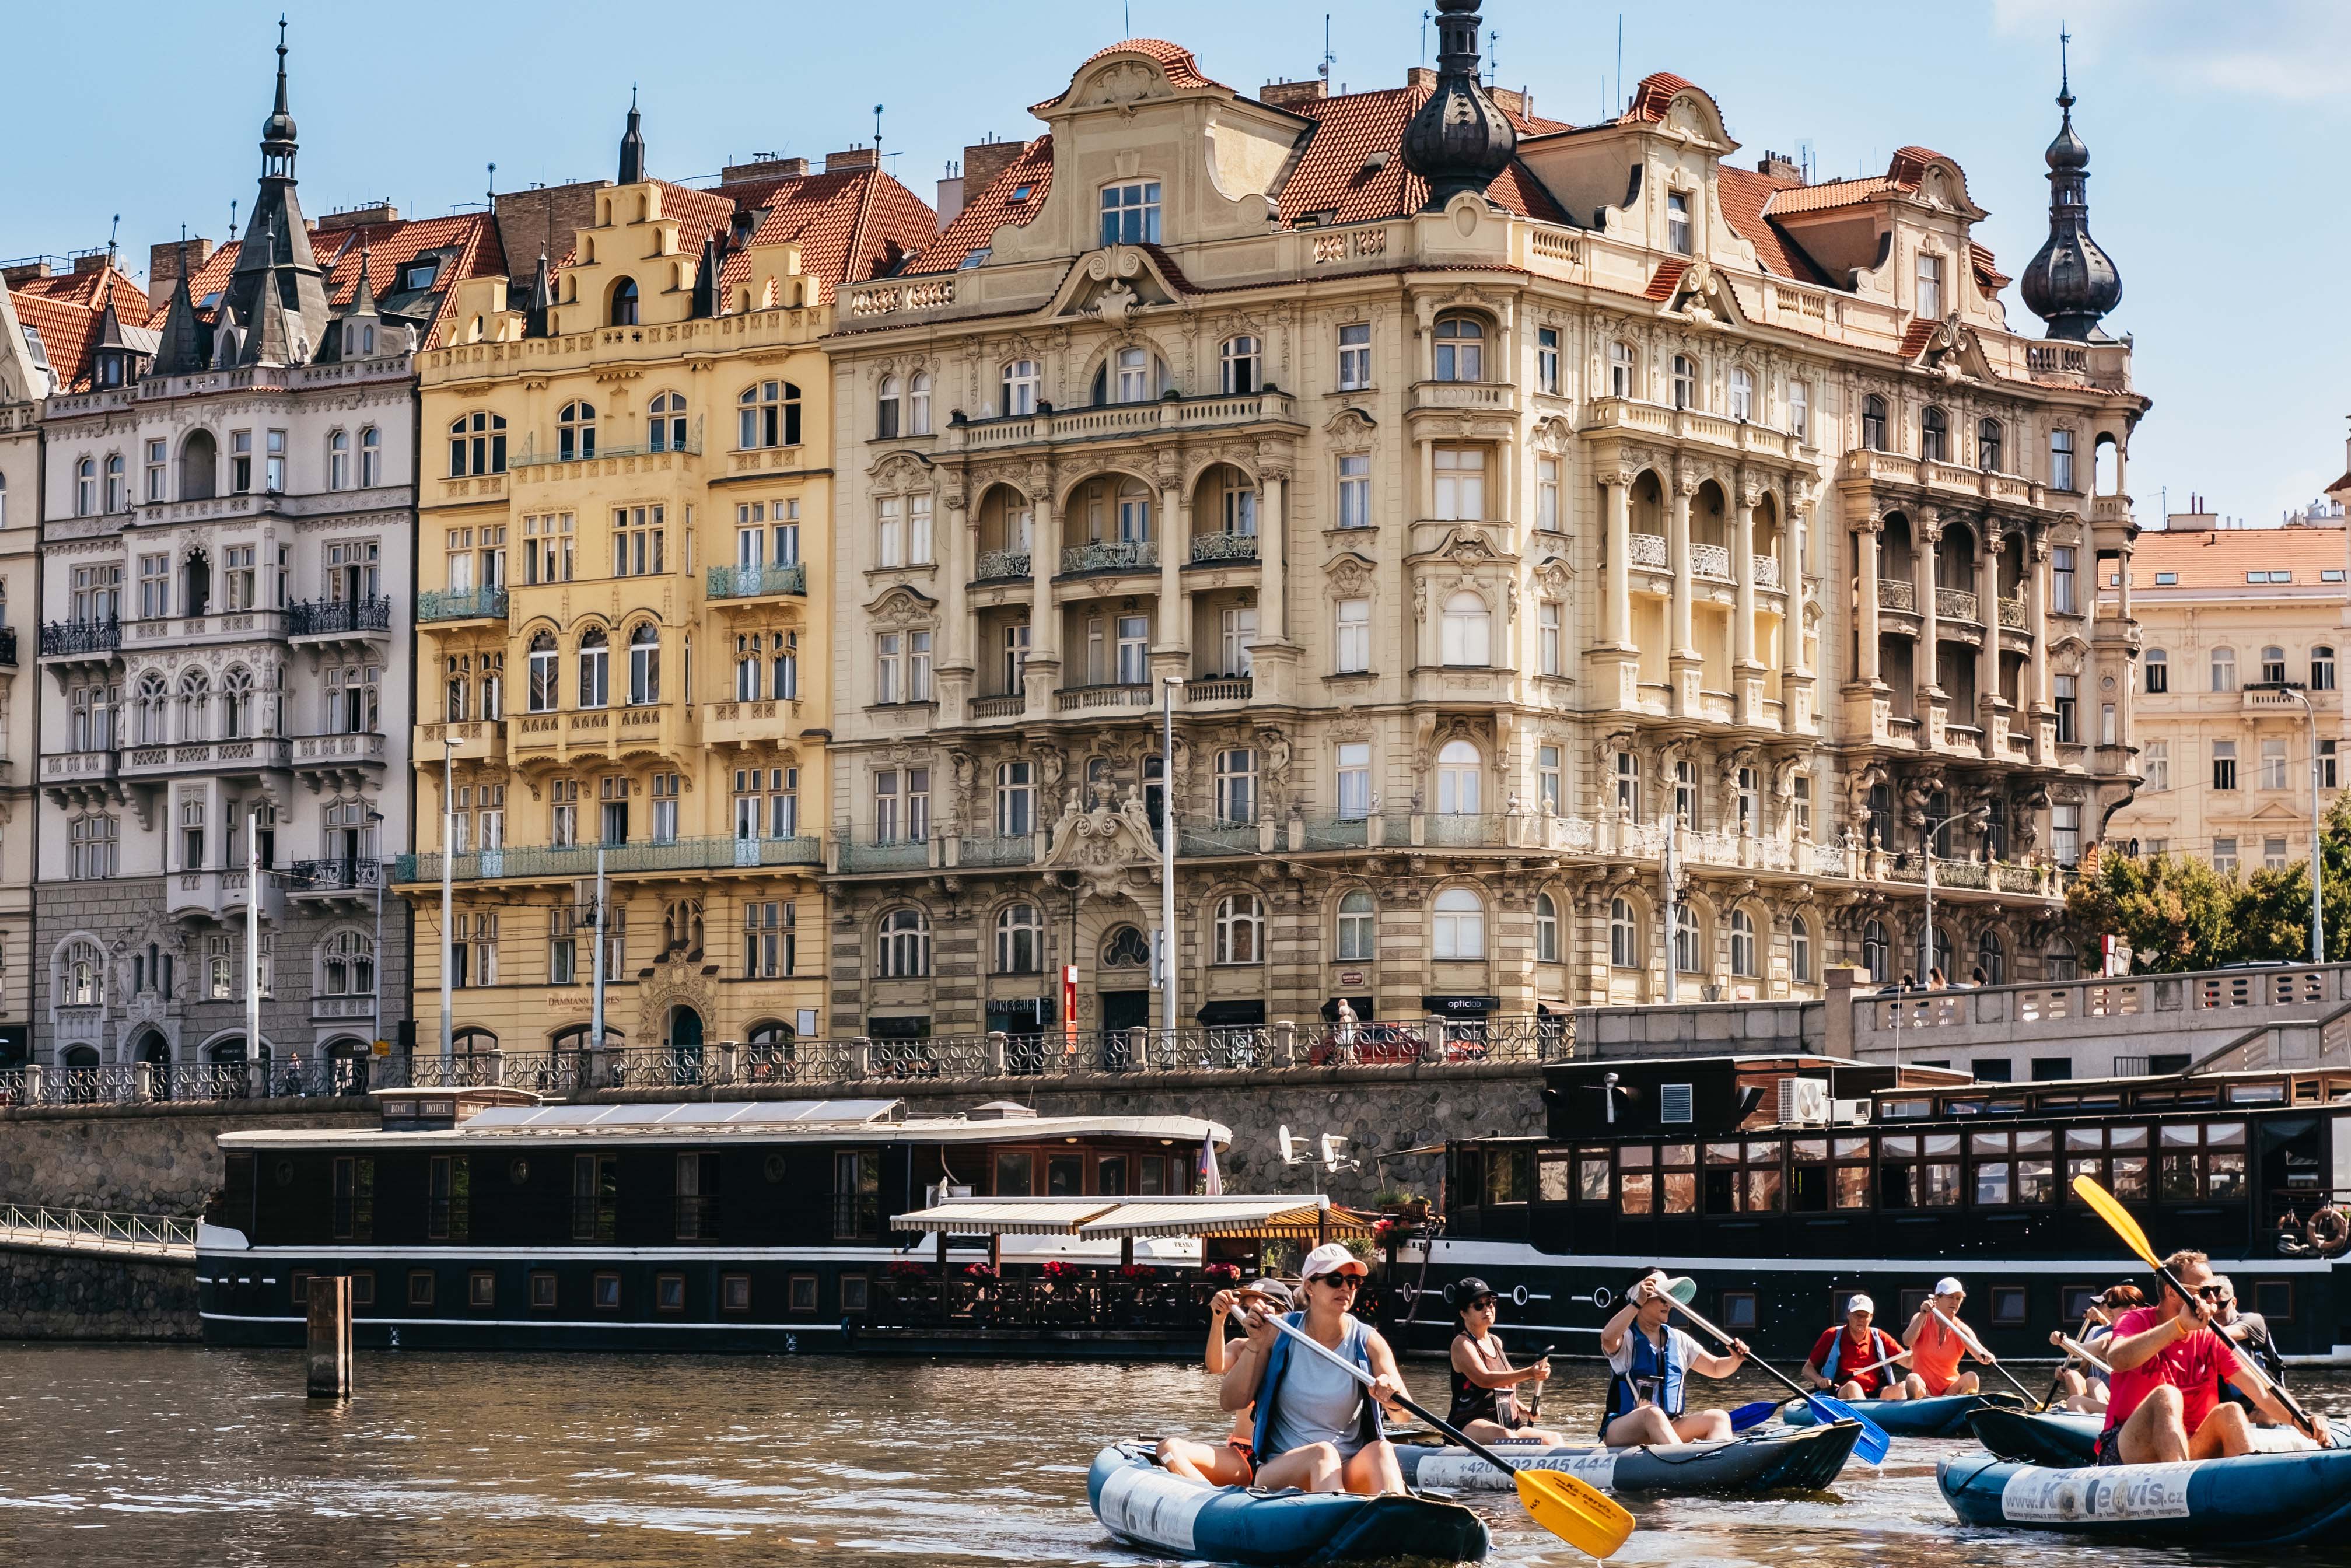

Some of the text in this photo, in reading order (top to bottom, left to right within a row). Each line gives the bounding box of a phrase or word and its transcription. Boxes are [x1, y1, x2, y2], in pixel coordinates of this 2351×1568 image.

[548, 997, 589, 1006] DAMMANN
[1447, 1000, 1481, 1009] opticlab
[391, 1104, 447, 1114] BOAT HOTEL
[467, 1104, 484, 1114] BOAT
[1460, 1462, 1493, 1474] +420
[1535, 1458, 1570, 1472] 845
[1573, 1456, 1613, 1471] 444
